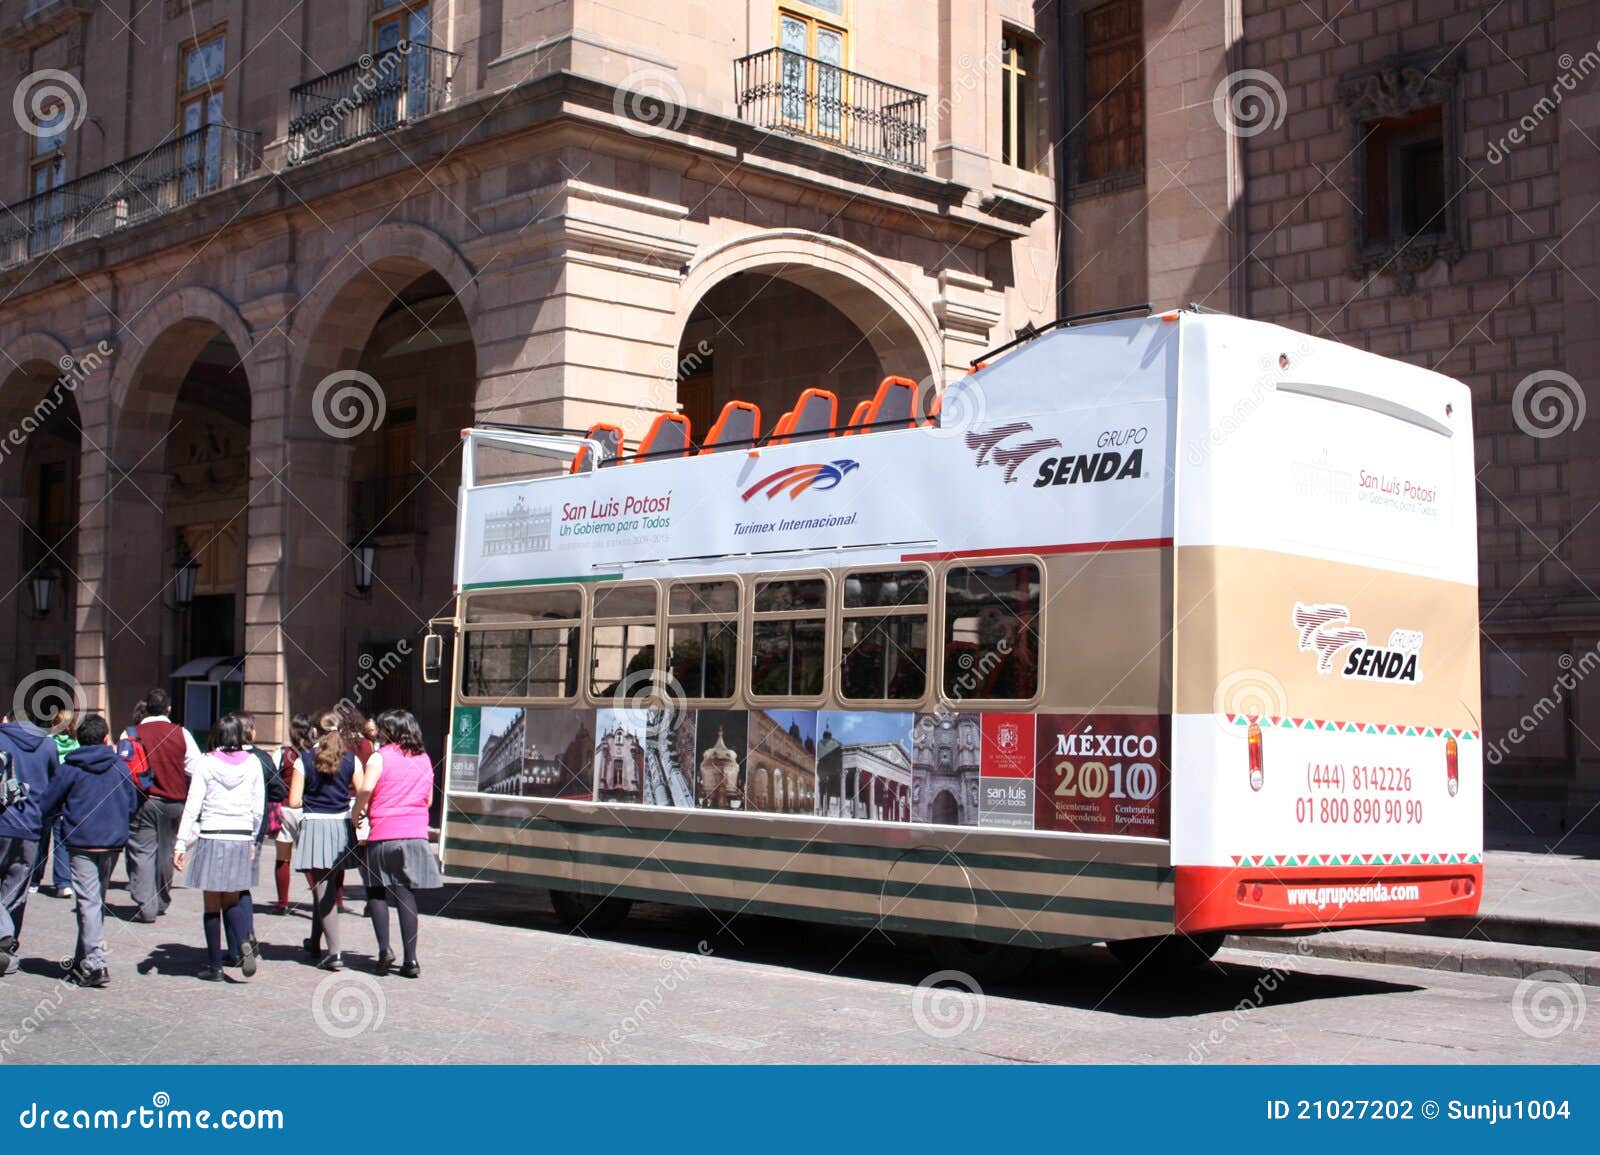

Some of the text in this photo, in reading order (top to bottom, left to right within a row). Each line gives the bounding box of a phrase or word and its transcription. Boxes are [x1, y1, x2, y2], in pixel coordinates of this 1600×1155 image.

[1097, 427, 1148, 448] GRUPO
[1033, 448, 1143, 488] SENDA
[1359, 469, 1378, 489] San
[1381, 474, 1401, 496] Luis
[561, 489, 672, 521] San Luis Potosí
[560, 515, 670, 536] Un Gobierno para Todos
[734, 512, 857, 535] Turimex Internacional
[1344, 647, 1417, 681] SENDA
[1055, 725, 1157, 758] MÉXICO
[1055, 761, 1157, 800] 2010
[1307, 762, 1412, 793] (444) 8142226
[987, 786, 1026, 800] san luis
[1055, 801, 1099, 812] Bicentenario
[1055, 812, 1106, 824] Independencia
[1115, 804, 1155, 814] Centenario
[1115, 815, 1155, 825] Revolución
[1296, 797, 1422, 824] 01 800 890 90 90
[1287, 882, 1419, 911] www.gruposenda.com
